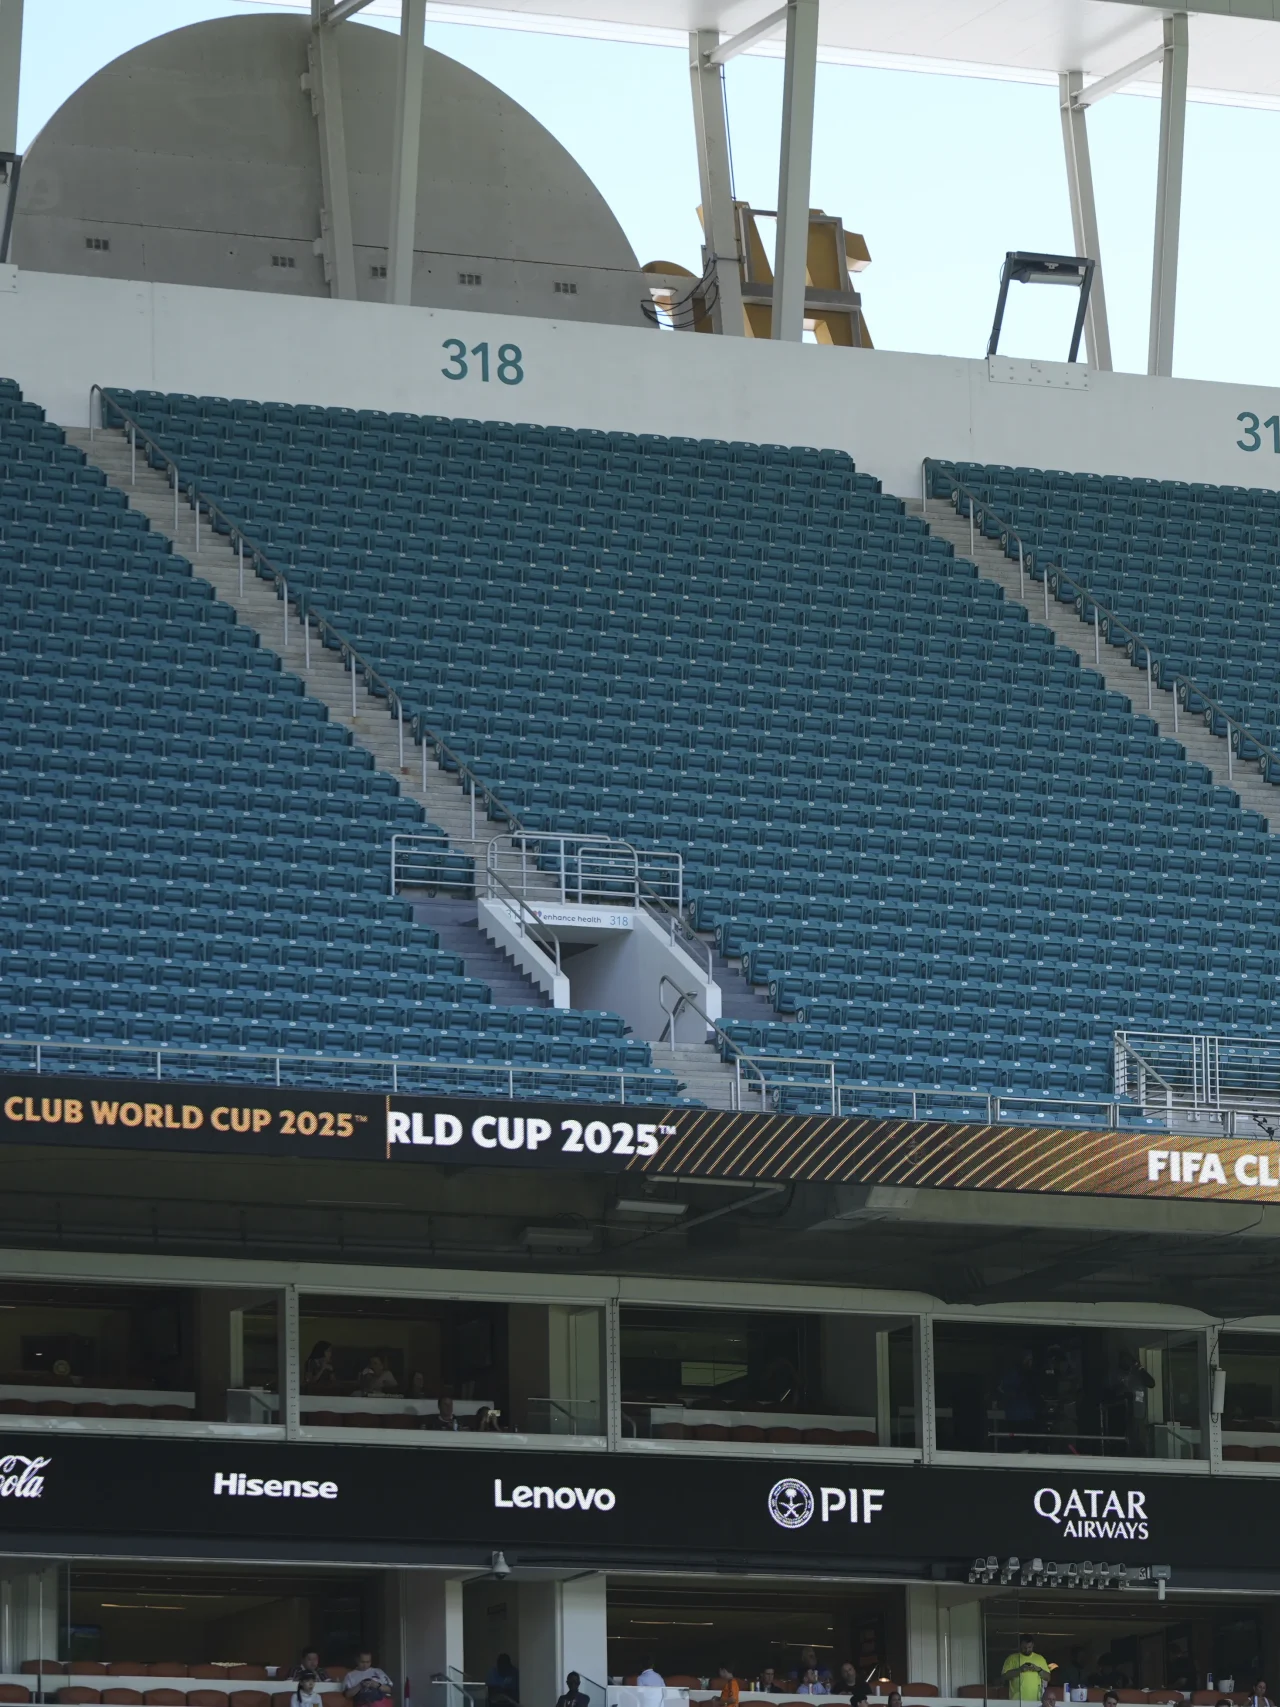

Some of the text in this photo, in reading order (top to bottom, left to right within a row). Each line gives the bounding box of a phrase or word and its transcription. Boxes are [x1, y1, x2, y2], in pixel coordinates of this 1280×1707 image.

[440, 338, 525, 386] 318
[543, 913, 576, 922] enhance
[577, 914, 602, 924] health
[609, 915, 629, 927] 318
[4, 1096, 84, 1124] CLUB
[91, 1100, 204, 1130] WORLD
[210, 1106, 272, 1133] CUP
[471, 1115, 552, 1150] CUP
[1148, 1149, 1228, 1185] FIFA
[213, 1472, 339, 1499] Hisense
[494, 1478, 616, 1511] Lenovo
[820, 1487, 885, 1524] PIF
[1033, 1487, 1149, 1524] QATAR
[1063, 1520, 1150, 1540] AIRWAYS
